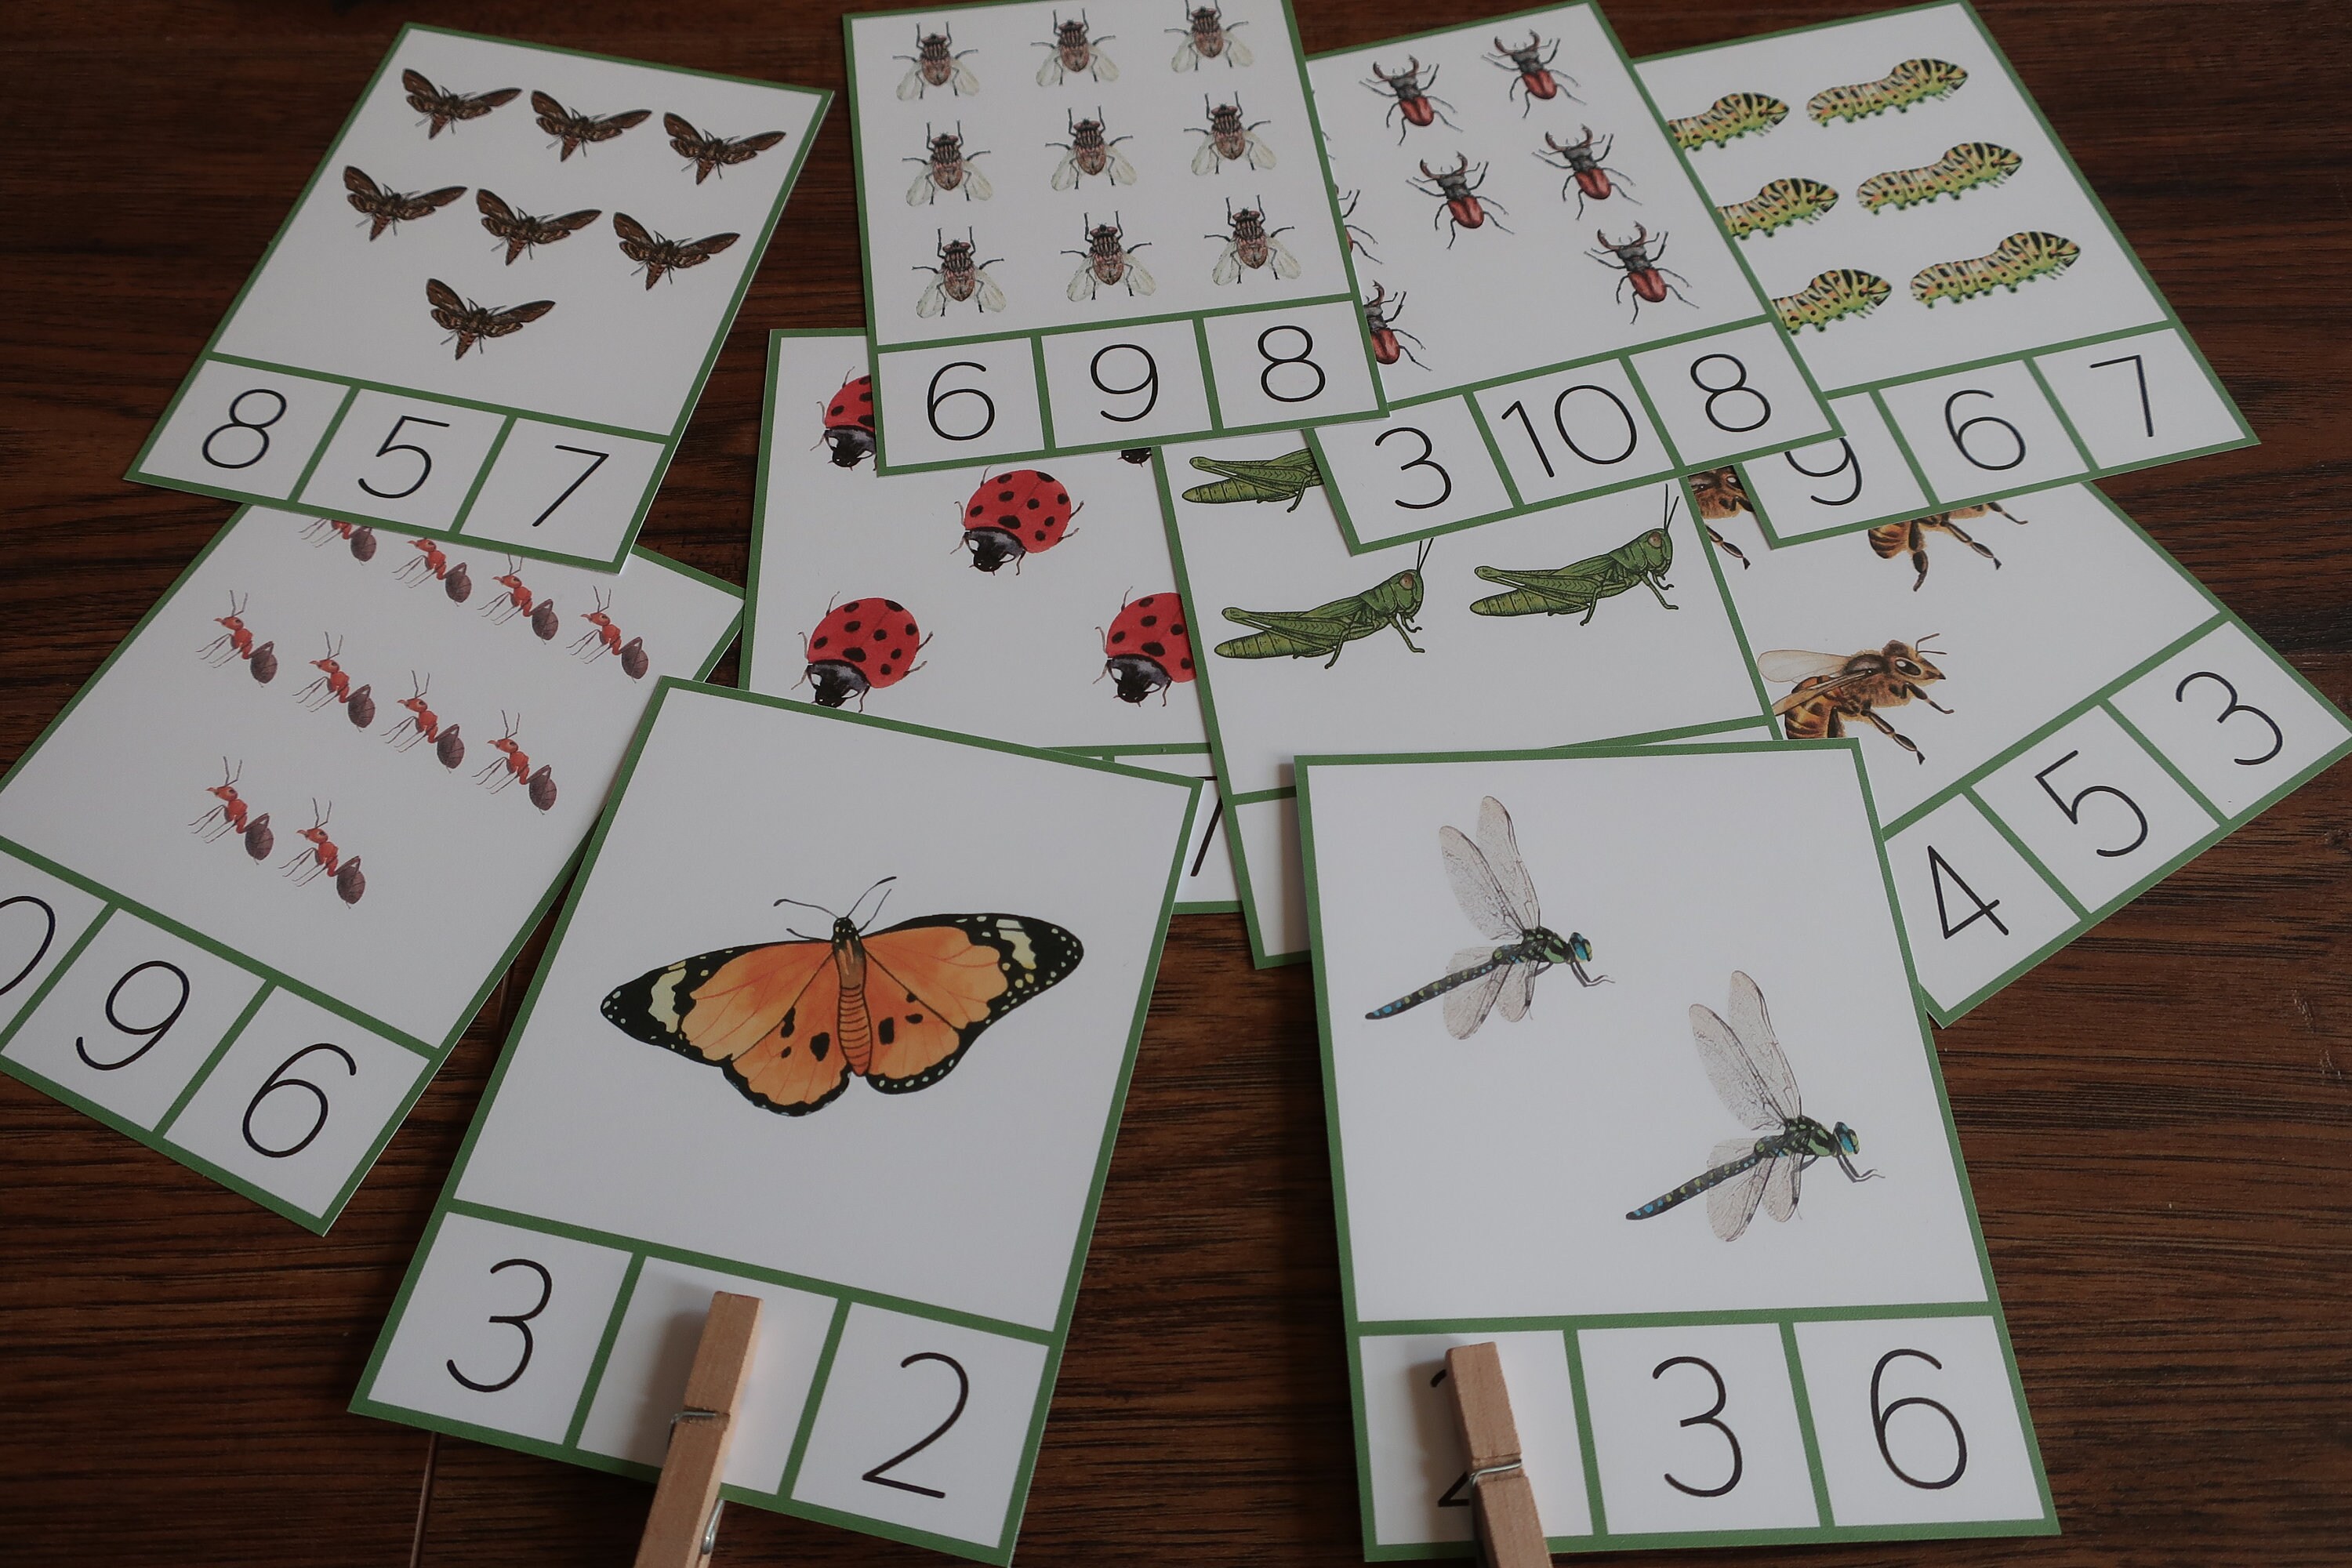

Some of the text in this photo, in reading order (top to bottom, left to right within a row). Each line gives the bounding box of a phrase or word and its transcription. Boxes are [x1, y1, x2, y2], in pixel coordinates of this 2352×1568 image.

[201, 388, 610, 528] 8 5 7
[927, 325, 1326, 441] 6 9 8
[1374, 354, 1771, 510] 3 10 8
[1784, 354, 2154, 506] 9 6 7
[1927, 670, 2283, 940] 4 5 3
[75, 960, 191, 1071] 9
[241, 1043, 357, 1159] 6
[446, 1258, 969, 1499] 3 2
[1651, 1348, 1968, 1497] 3 6
